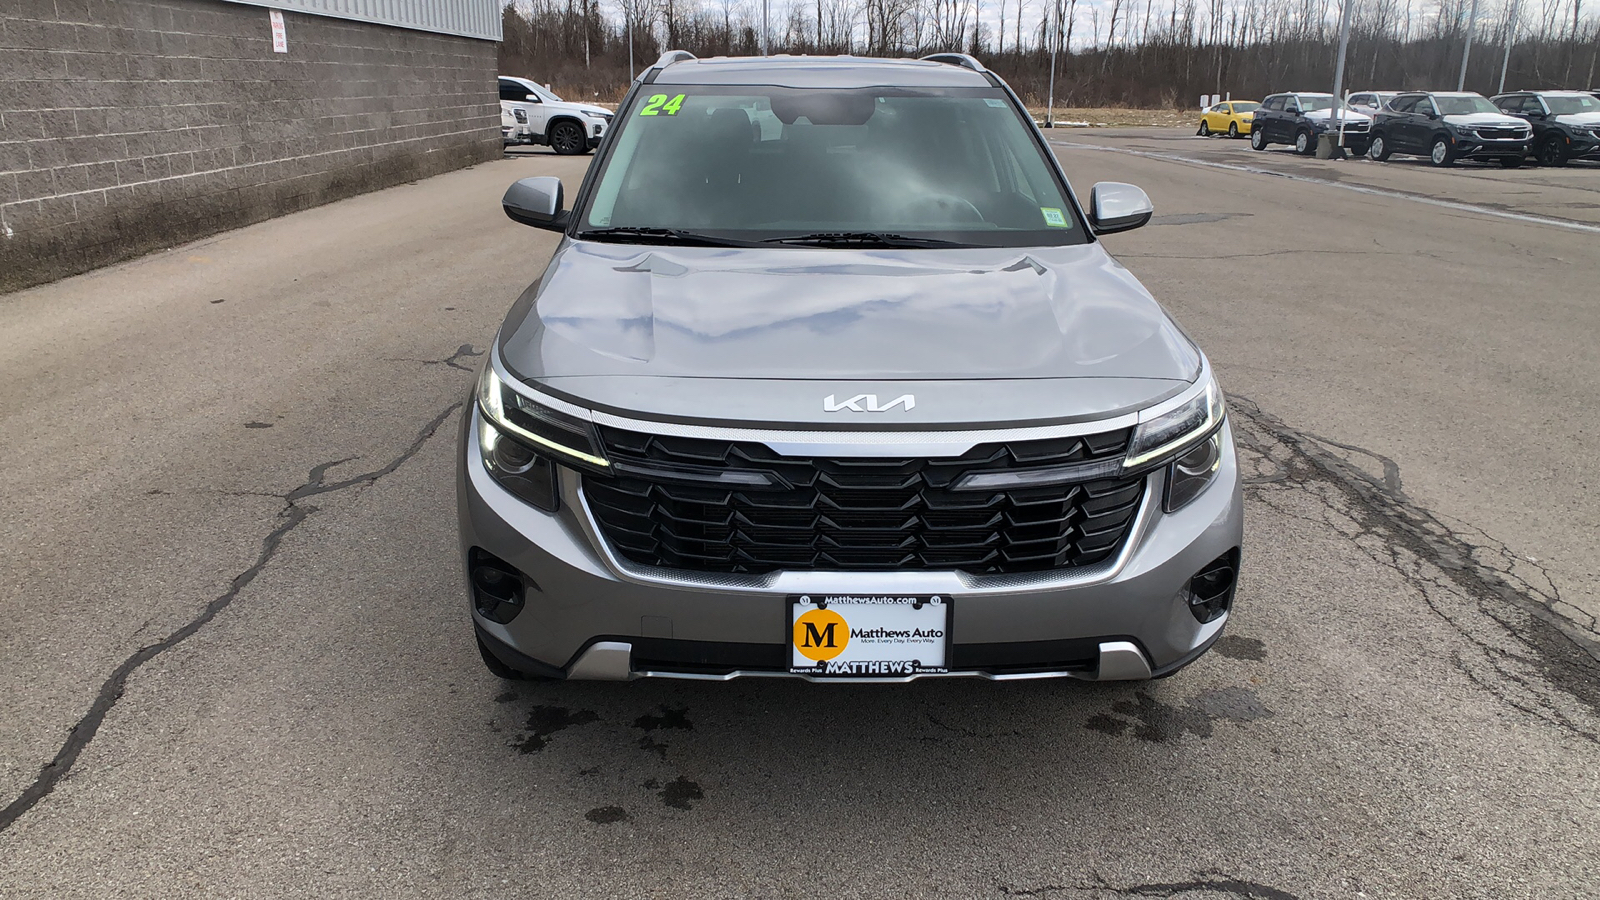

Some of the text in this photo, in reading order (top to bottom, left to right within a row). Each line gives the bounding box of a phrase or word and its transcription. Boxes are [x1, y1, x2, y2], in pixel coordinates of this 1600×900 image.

[640, 94, 686, 116] 24
[823, 394, 916, 412] KIA
[824, 596, 917, 605] MatthewsAuto.com
[800, 621, 839, 648] M
[850, 626, 944, 639] Matthews Auto
[825, 661, 914, 674] MATTHEWS
